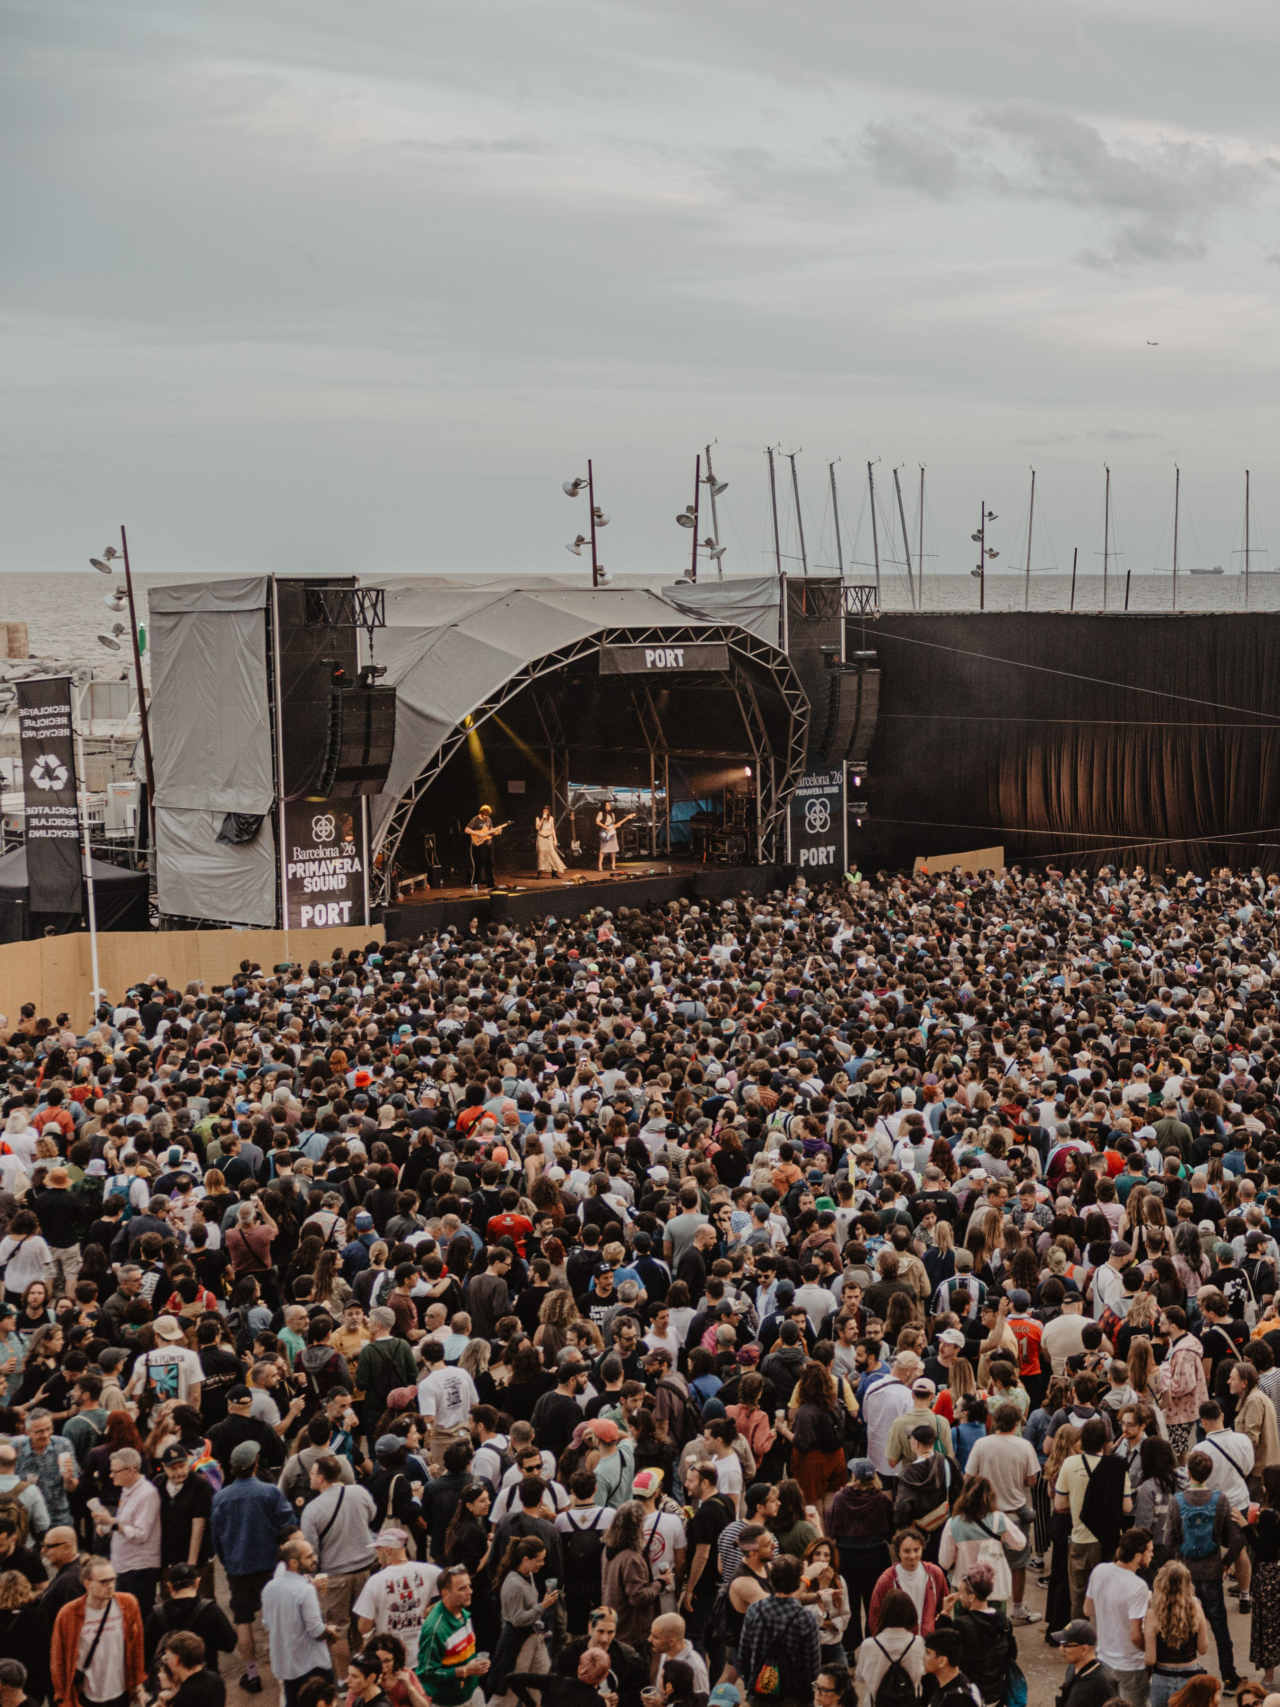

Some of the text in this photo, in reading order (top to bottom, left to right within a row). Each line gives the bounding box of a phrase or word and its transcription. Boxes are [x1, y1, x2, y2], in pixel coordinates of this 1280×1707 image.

[645, 649, 684, 668] PORT
[796, 786, 839, 796] PRIMAVERA SOUND
[293, 845, 340, 861] Barcelona
[800, 845, 836, 868] PORT
[288, 857, 362, 879] PRIMAVERA
[303, 874, 347, 893] SOUND
[301, 901, 352, 928] PORT
[1020, 1336, 1028, 1359] 1
